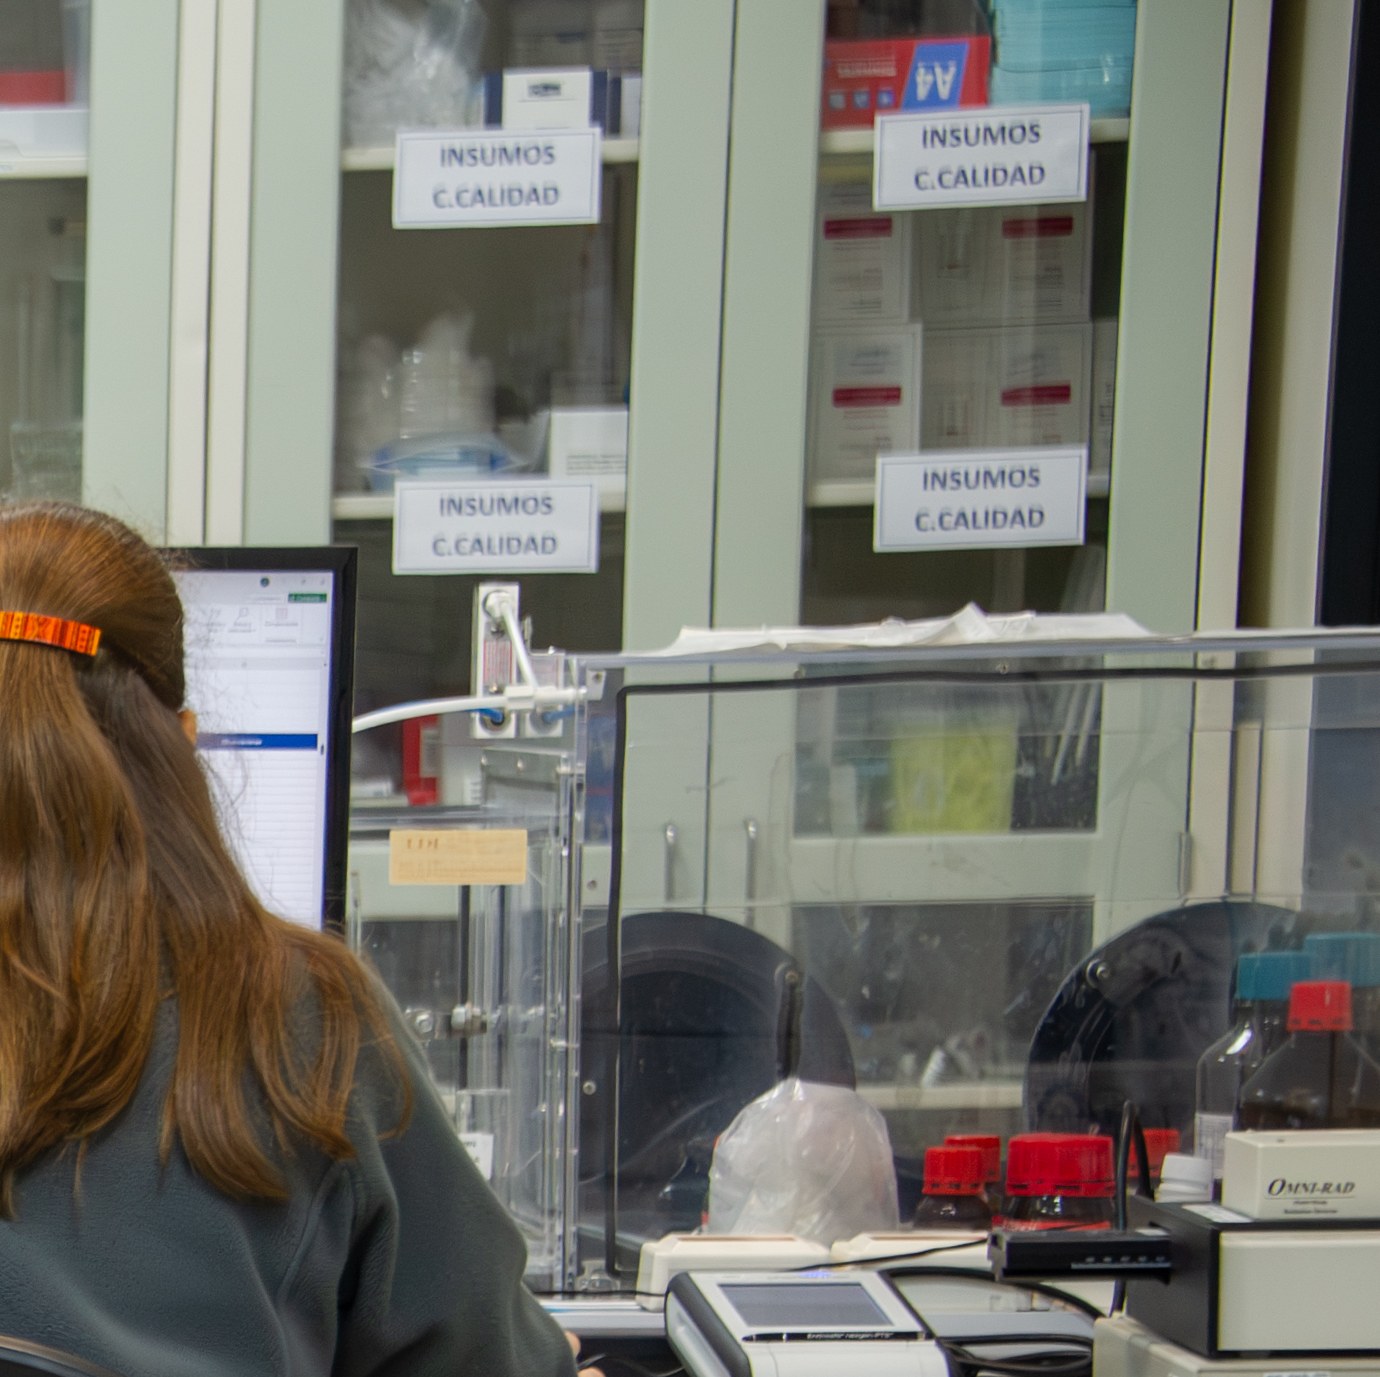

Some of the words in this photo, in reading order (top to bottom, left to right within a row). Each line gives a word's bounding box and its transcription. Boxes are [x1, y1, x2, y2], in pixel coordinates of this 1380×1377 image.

[916, 63, 957, 101] A4
[922, 120, 1041, 148] INSUMOS
[439, 143, 556, 169] INSUMOS
[914, 162, 1045, 192] C.CALIDAD
[432, 181, 560, 210] C.CALIDAD
[923, 466, 1041, 492] INSUMOS
[438, 493, 554, 518] INSUMOS
[914, 503, 1045, 533] C.CALIDAD
[432, 532, 558, 559] C.CALIDAD
[1268, 1178, 1355, 1197] OMNI-RAD
